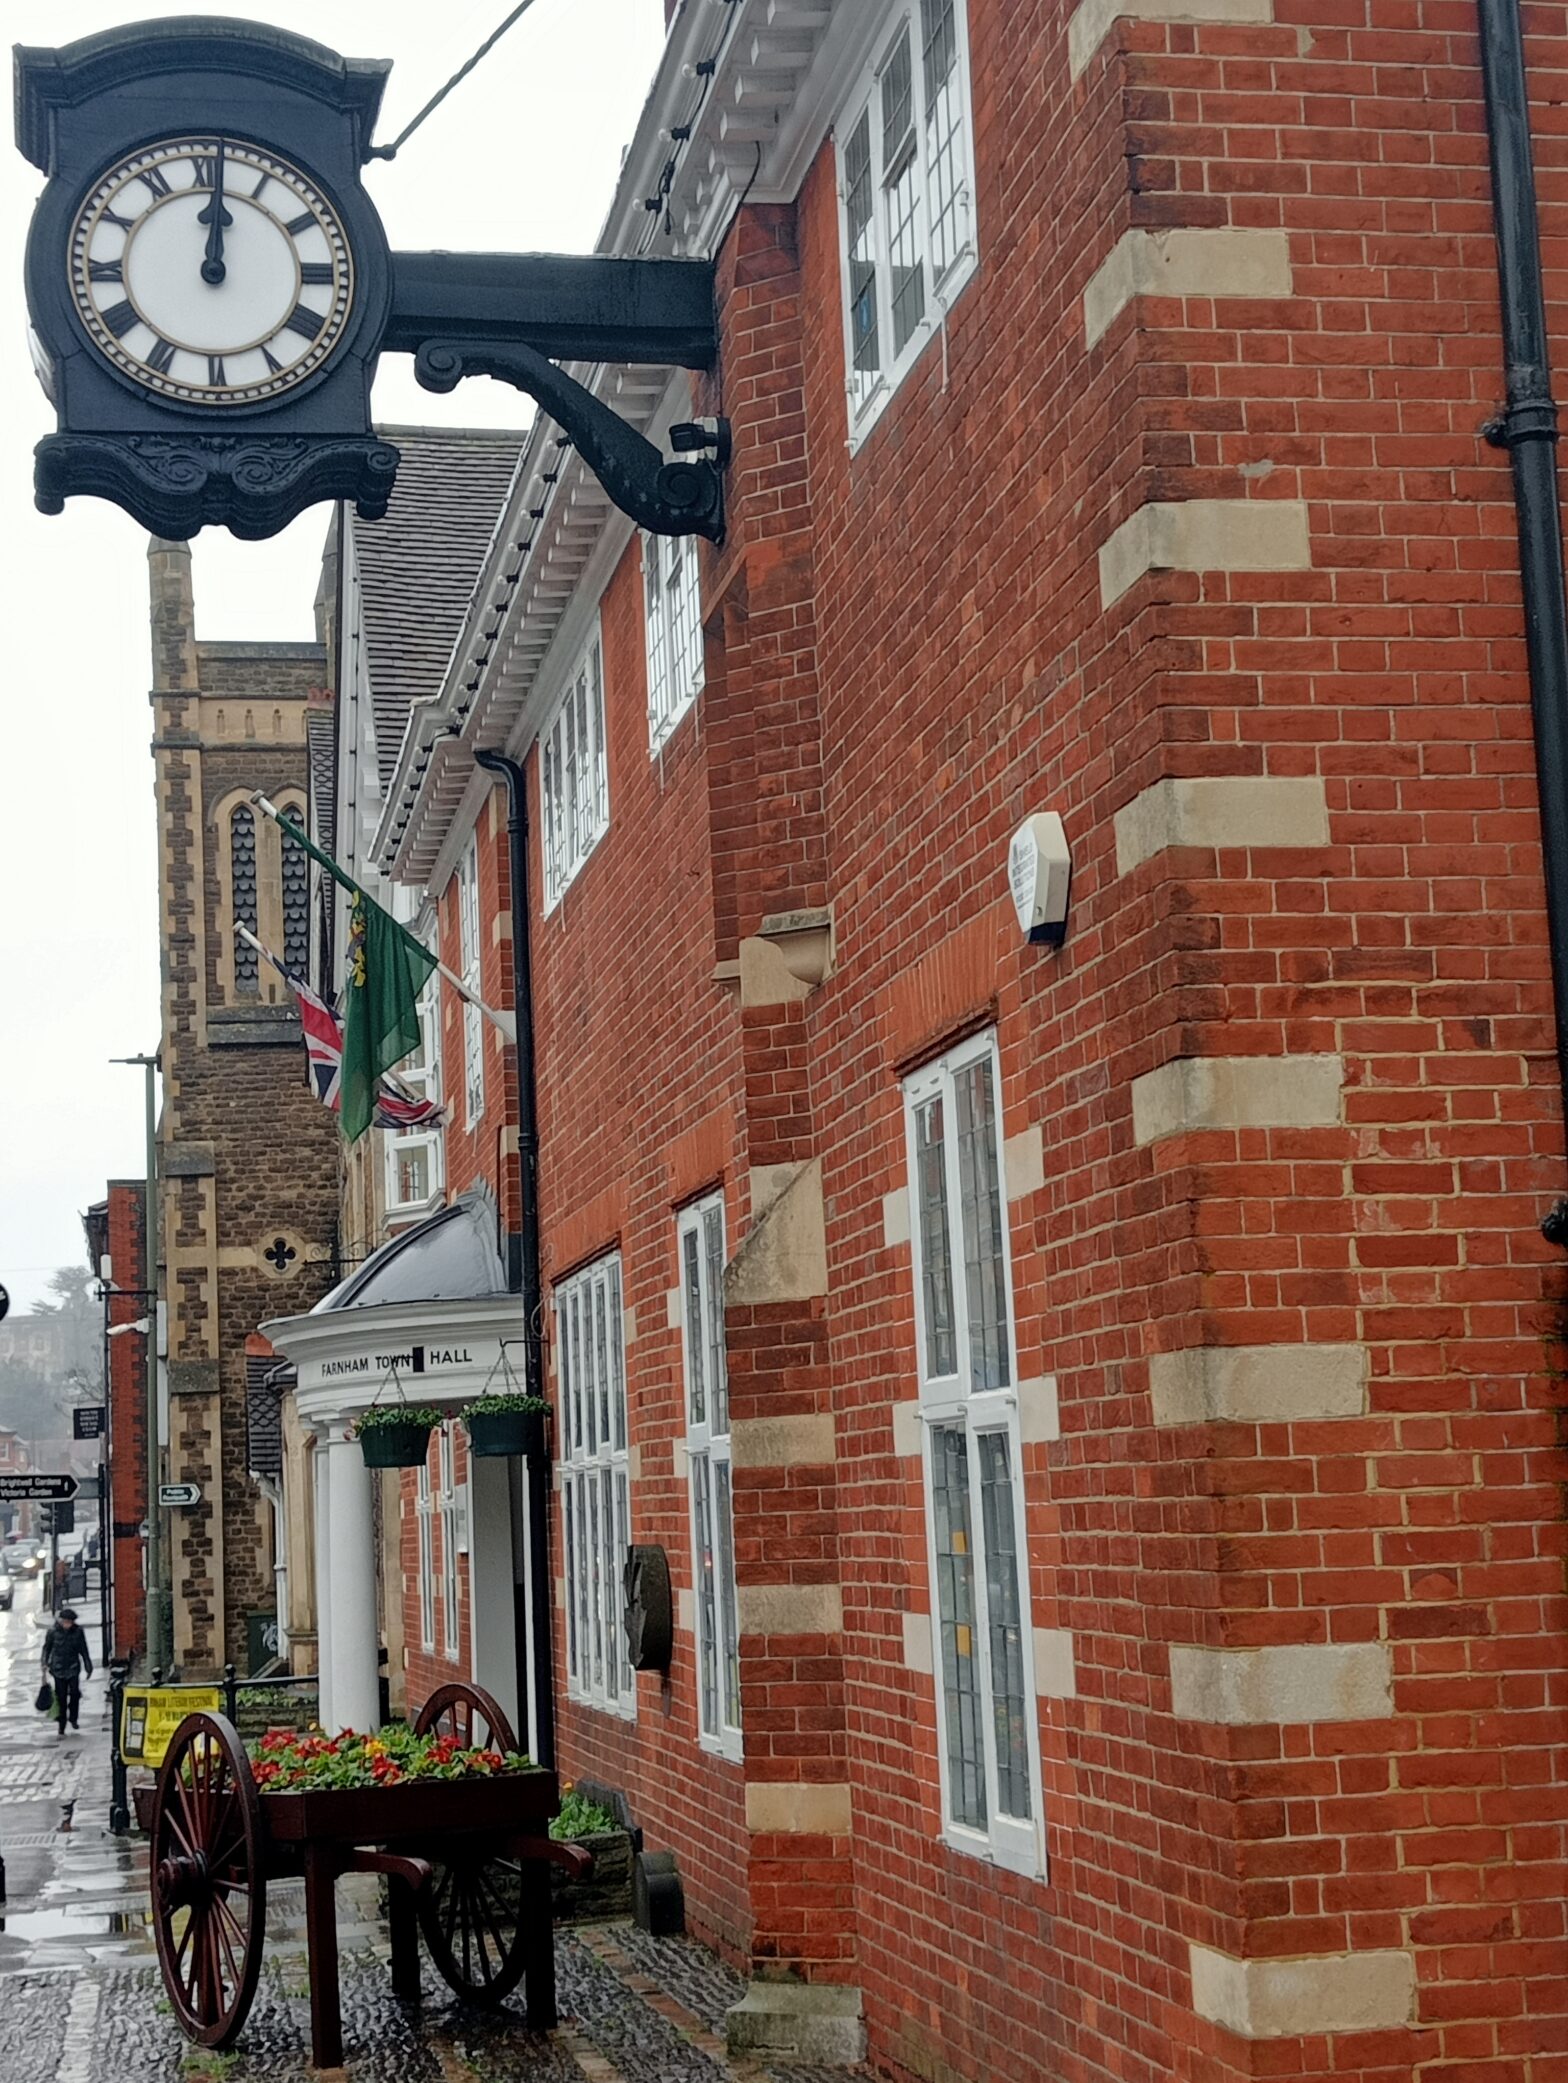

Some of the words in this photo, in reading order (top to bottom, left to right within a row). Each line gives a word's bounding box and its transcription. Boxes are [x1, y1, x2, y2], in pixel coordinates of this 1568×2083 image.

[136, 167, 174, 202] XI
[252, 172, 272, 199] I
[100, 205, 135, 233] X
[284, 210, 320, 236] II
[88, 257, 124, 282] IX
[300, 262, 334, 284] III
[207, 355, 228, 386] VI
[260, 345, 285, 374] V
[322, 1357, 368, 1377] FARNHAM
[375, 1353, 410, 1370] TOWN
[430, 1349, 472, 1364] HALL
